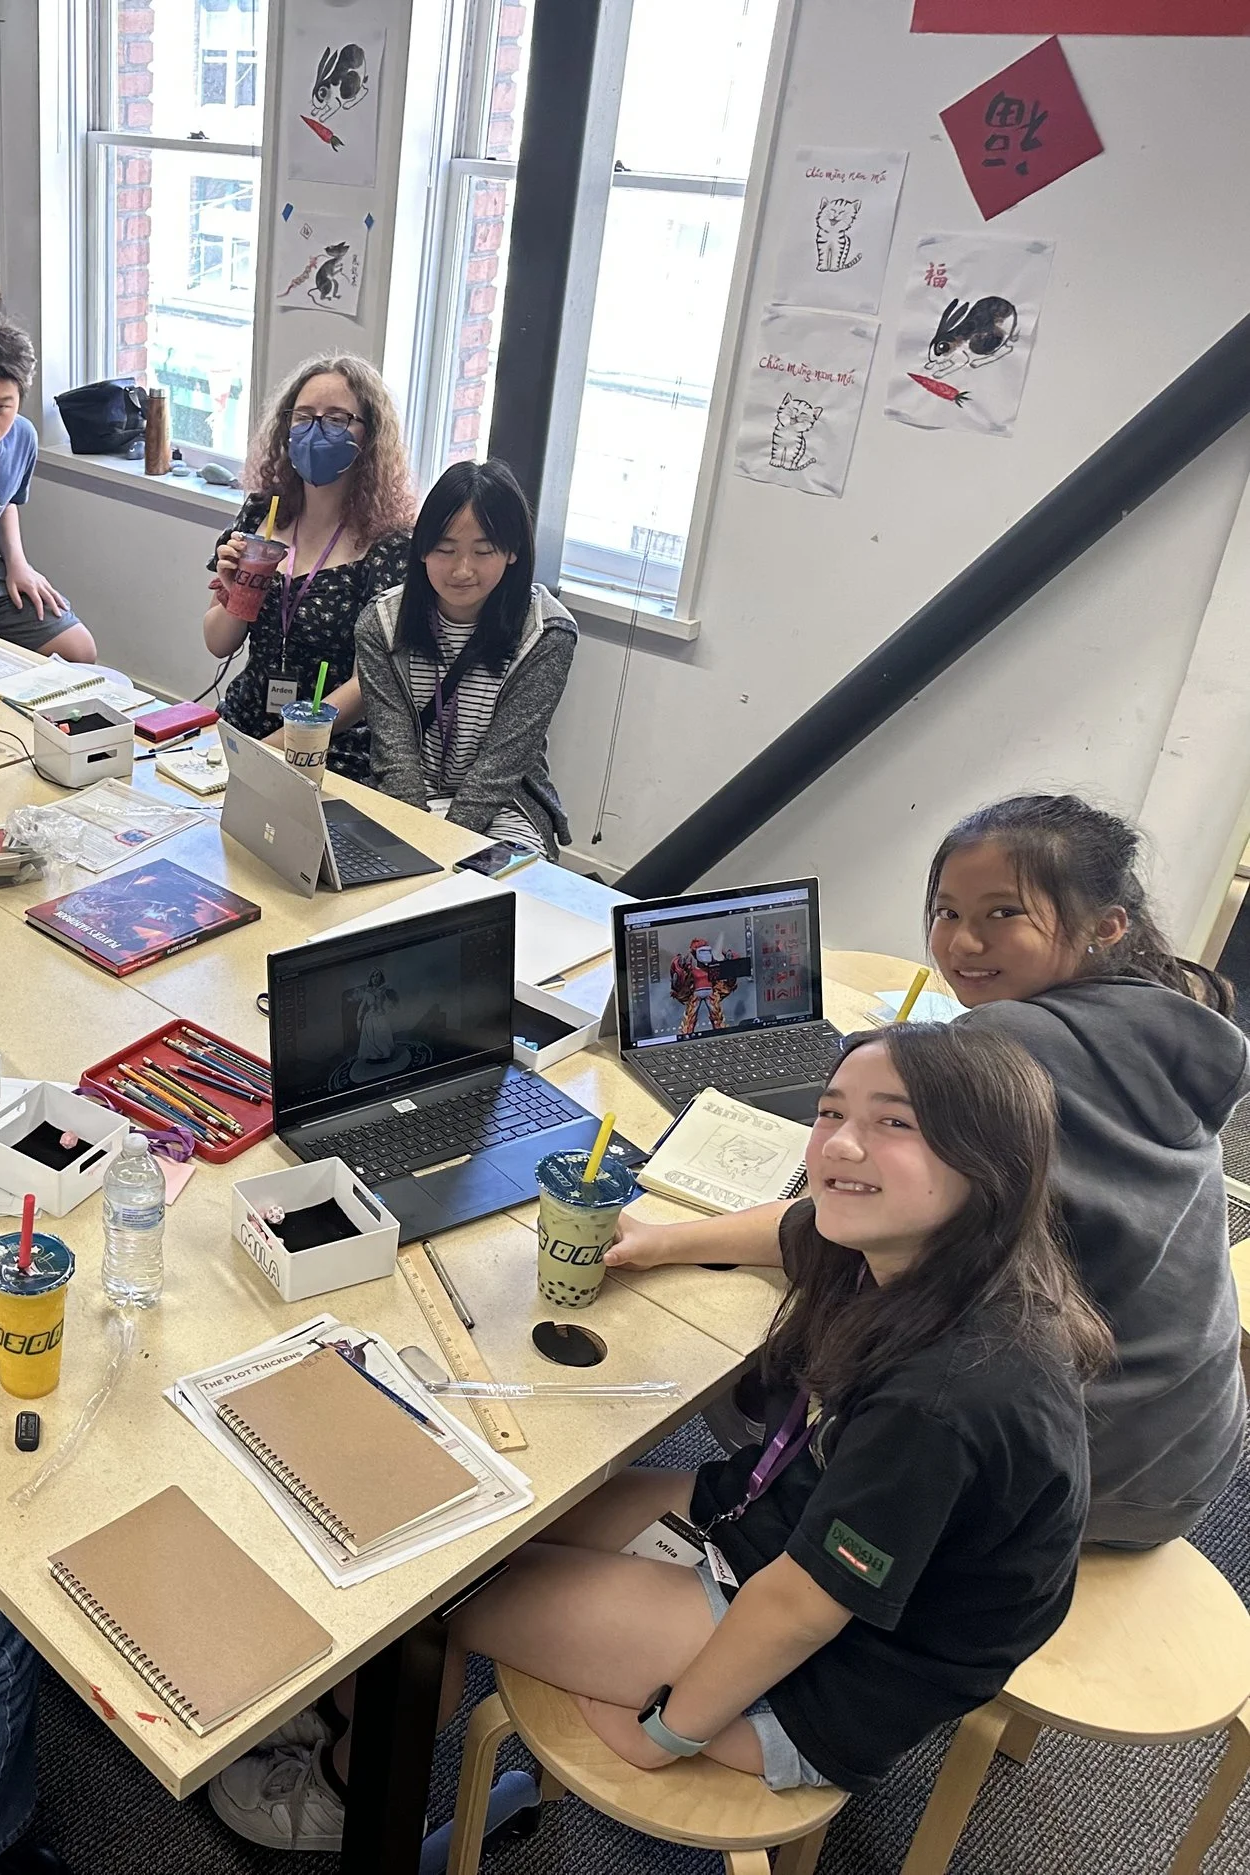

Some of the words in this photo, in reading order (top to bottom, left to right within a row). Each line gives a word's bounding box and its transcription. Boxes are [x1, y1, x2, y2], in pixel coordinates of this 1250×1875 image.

[924, 262, 949, 290] 福
[758, 353, 784, 372] Chúc
[270, 686, 293, 695] Arden
[53, 910, 92, 935] HANDBOOK
[241, 1223, 280, 1288] MILA
[200, 1378, 223, 1391] THE
[224, 1367, 252, 1384] PLOT
[251, 1351, 304, 1373] THICKENS
[655, 1540, 679, 1559] Mila
